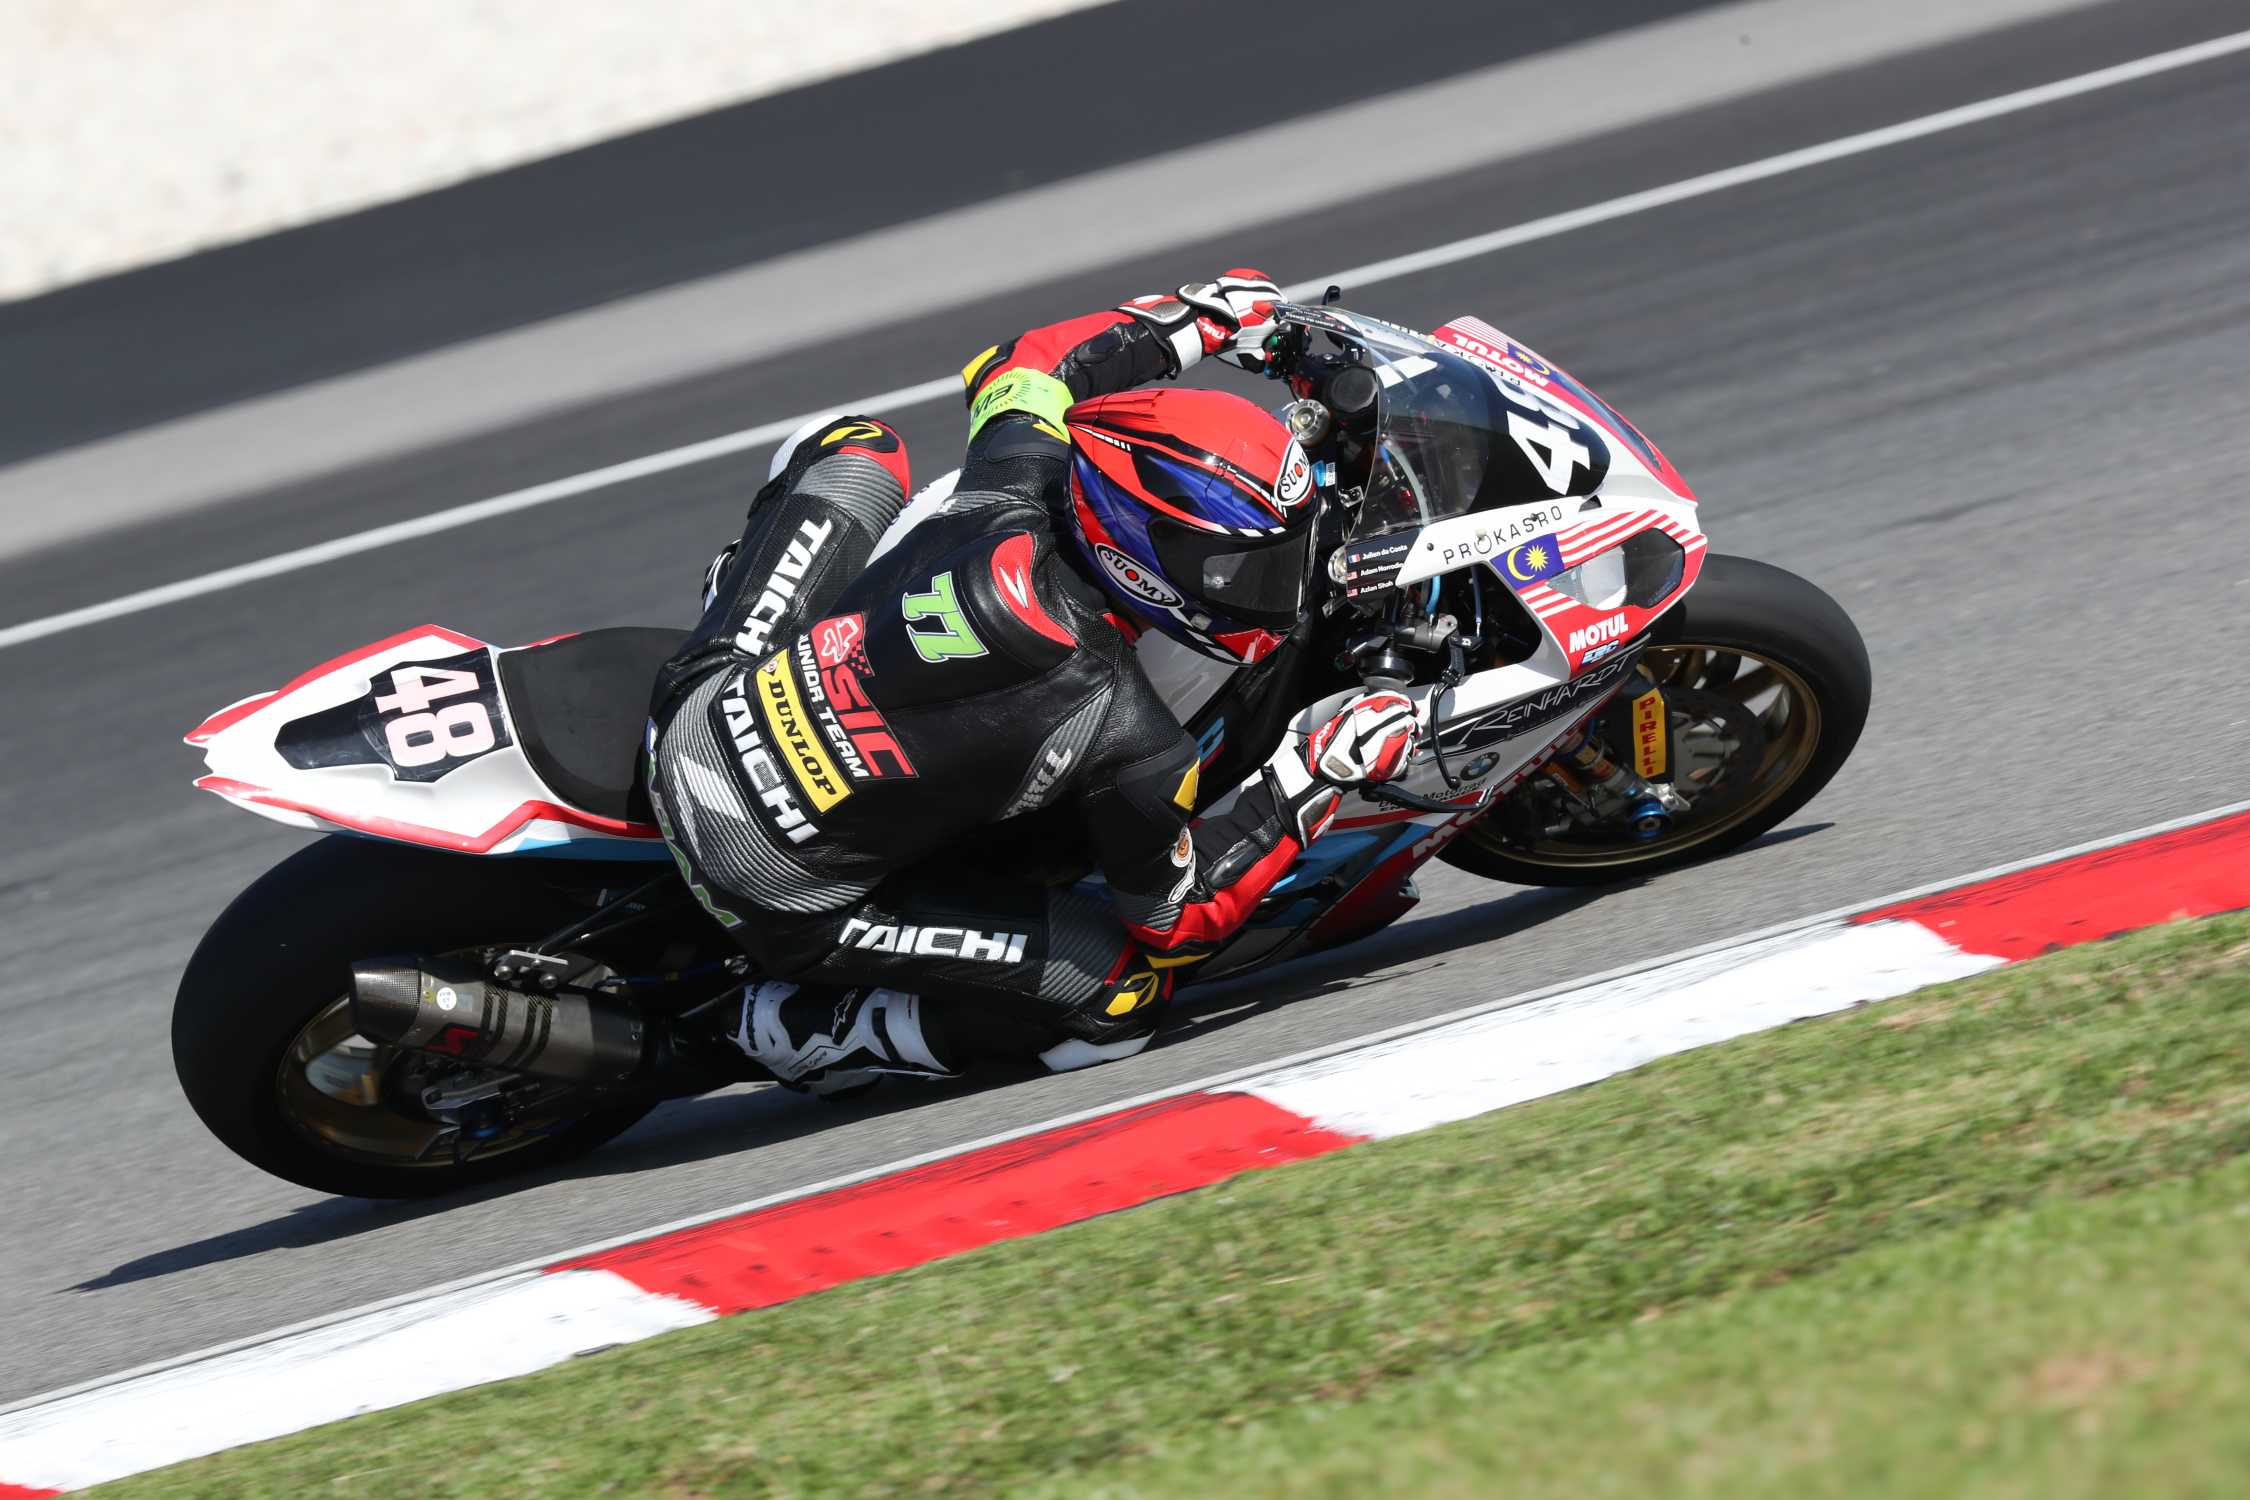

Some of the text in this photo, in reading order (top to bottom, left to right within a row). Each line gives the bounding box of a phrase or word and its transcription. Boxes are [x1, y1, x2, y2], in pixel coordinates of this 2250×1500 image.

[1452, 333, 1549, 387] MOTUL
[1280, 451, 1310, 493] SUOM
[1381, 547, 1390, 555] da
[1390, 544, 1408, 554] Costa
[1443, 505, 1562, 565] PROKASRO
[733, 519, 832, 657] TAICH
[1100, 549, 1175, 605] SUOMY
[1569, 612, 1629, 654] MOTUL
[375, 665, 496, 768] 48
[798, 633, 870, 778] UNIOR TEAM
[821, 664, 915, 777] SIC
[1457, 643, 1645, 746] REINHARDT
[722, 672, 821, 845] TAICHI
[768, 679, 837, 797] DUNLOP
[1639, 696, 1657, 776] PIRELLI
[838, 918, 1029, 963] TAICHI
